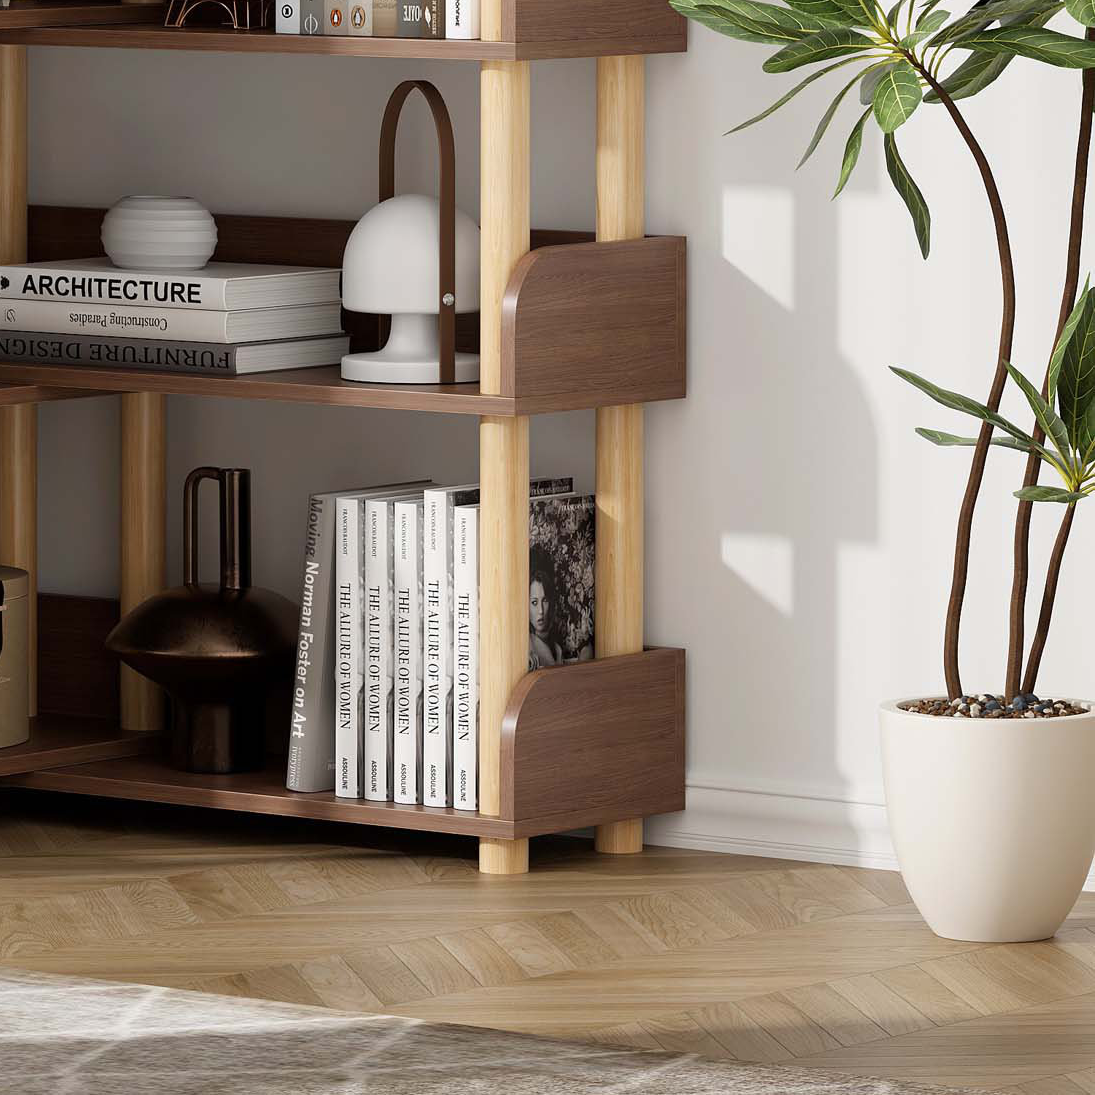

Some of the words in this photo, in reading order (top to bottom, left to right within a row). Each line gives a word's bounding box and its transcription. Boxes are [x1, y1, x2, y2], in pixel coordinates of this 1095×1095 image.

[22, 274, 202, 304] ARCHITECTURE
[69, 312, 108, 327] Paradies
[109, 312, 168, 331] Constructing
[89, 343, 230, 369] FURNITURE
[306, 497, 323, 557] Moving
[301, 561, 319, 627] Norman
[339, 583, 351, 608] THE
[369, 586, 380, 611] THE
[398, 588, 410, 614] THE
[428, 580, 439, 607] THE
[458, 593, 470, 619] THE
[339, 611, 351, 659] ALLURE
[369, 614, 380, 662] ALLURE
[398, 616, 410, 665] ALLURE
[428, 610, 439, 660] ALLURE
[458, 621, 470, 670] ALLURE
[297, 632, 314, 684] Foster
[339, 661, 351, 680] OF
[369, 664, 380, 682] OF
[398, 667, 410, 684] OF
[428, 663, 439, 681] OF
[458, 672, 470, 689] OF
[294, 687, 305, 708] on
[339, 681, 351, 729] WOMEN
[369, 684, 380, 732] WOMEN
[398, 686, 410, 735] WOMEN
[428, 684, 439, 735] WOMEN
[292, 712, 307, 739] Art
[458, 691, 470, 741] WOMEN
